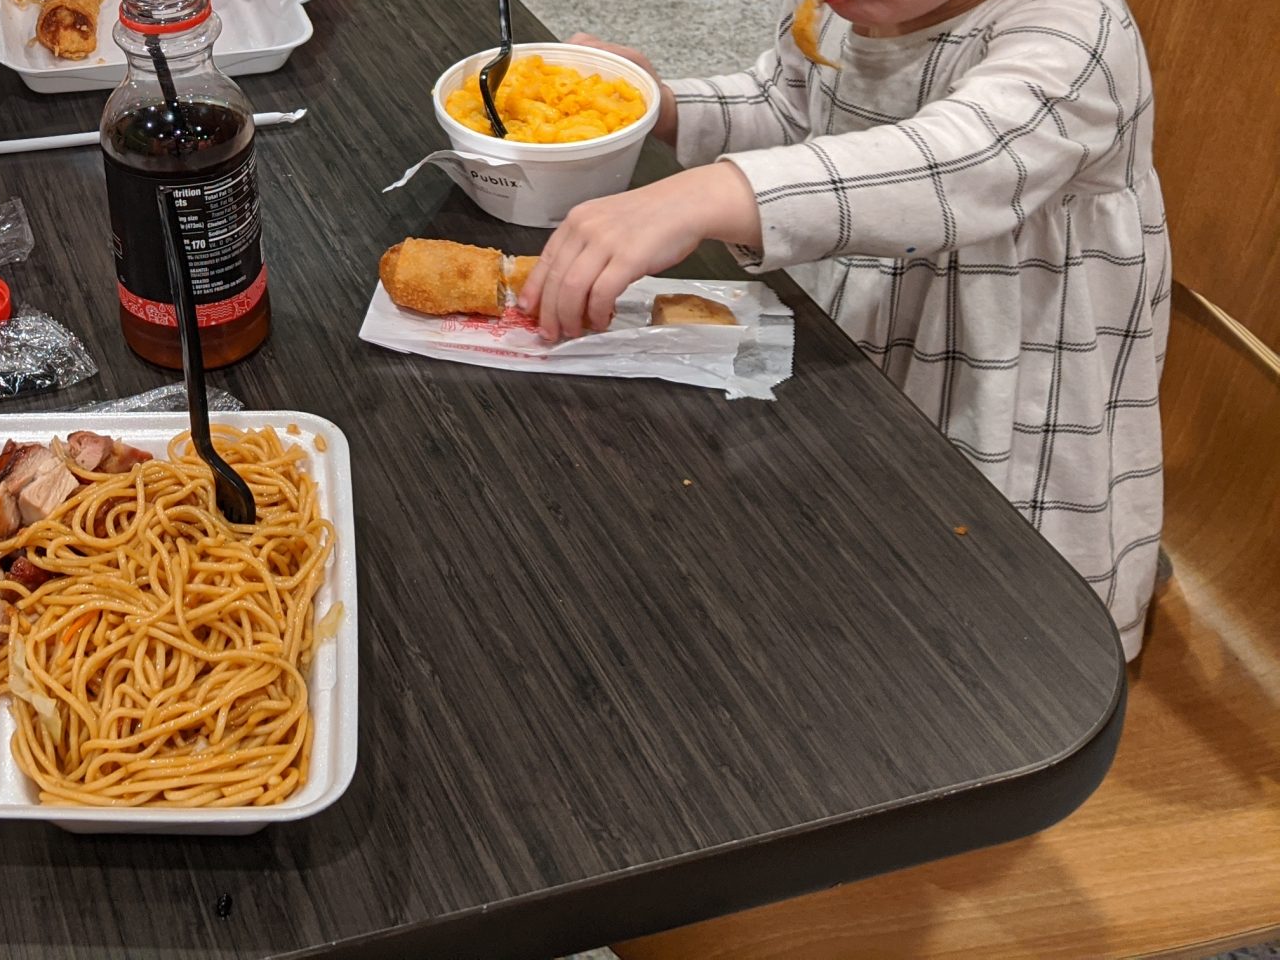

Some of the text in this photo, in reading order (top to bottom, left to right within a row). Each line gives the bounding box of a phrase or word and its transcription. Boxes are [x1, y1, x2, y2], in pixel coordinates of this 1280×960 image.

[470, 170, 518, 188] Publix
[172, 188, 201, 198] trition
[204, 192, 219, 201] Total
[174, 199, 188, 207] cts
[191, 239, 206, 249] 170
